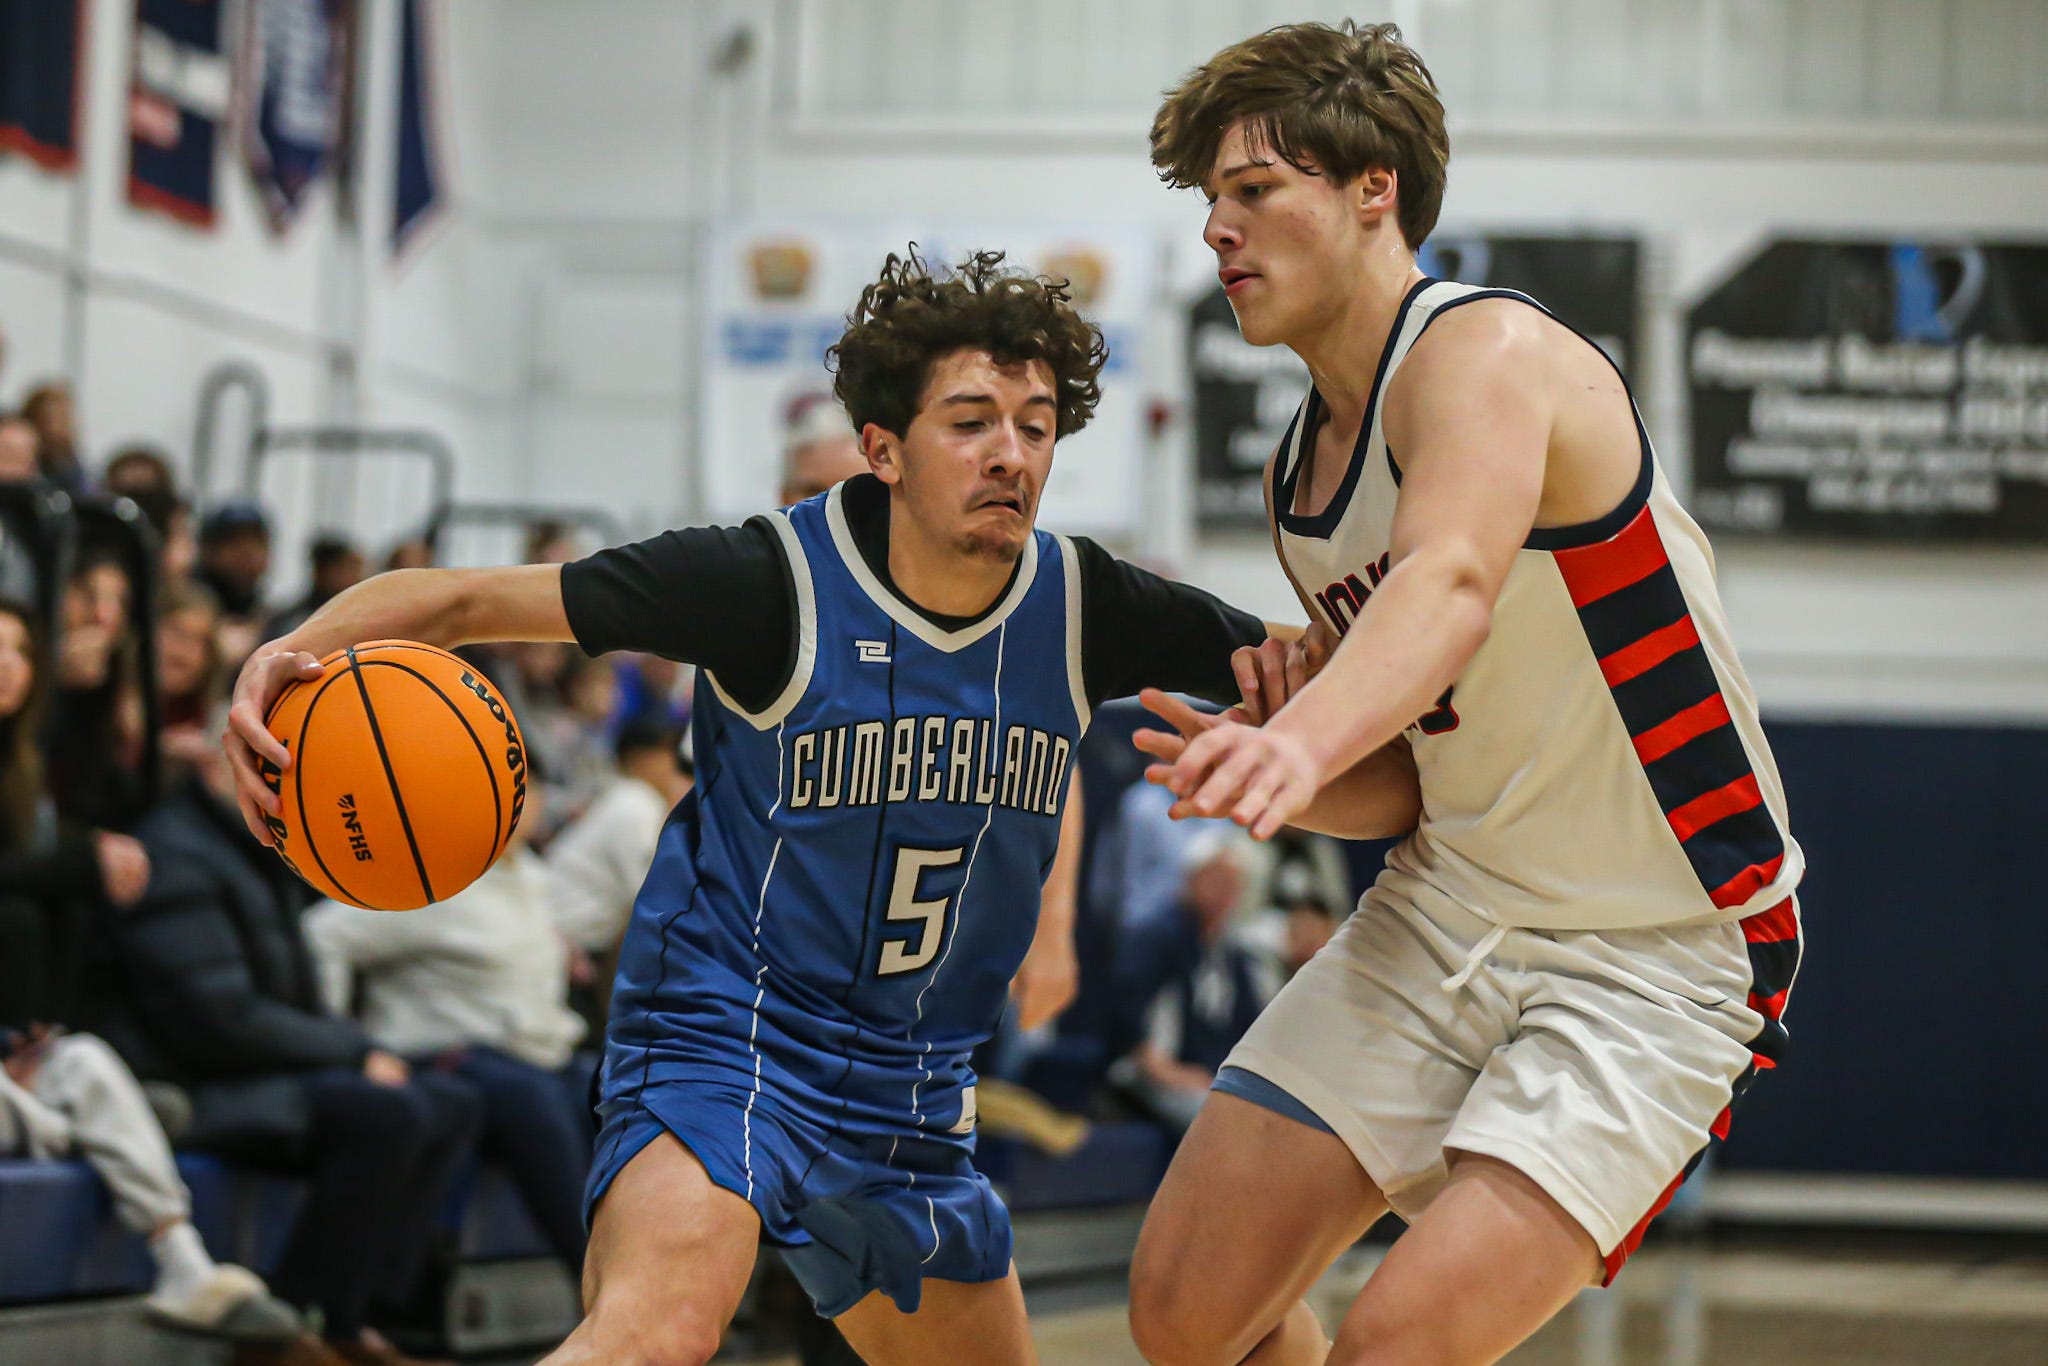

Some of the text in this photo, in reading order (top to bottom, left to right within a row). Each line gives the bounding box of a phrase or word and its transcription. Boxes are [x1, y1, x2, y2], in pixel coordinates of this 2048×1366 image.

[789, 716, 1071, 816] CUMBERLAND
[340, 809, 374, 863] NFHS
[876, 845, 965, 977] 5
